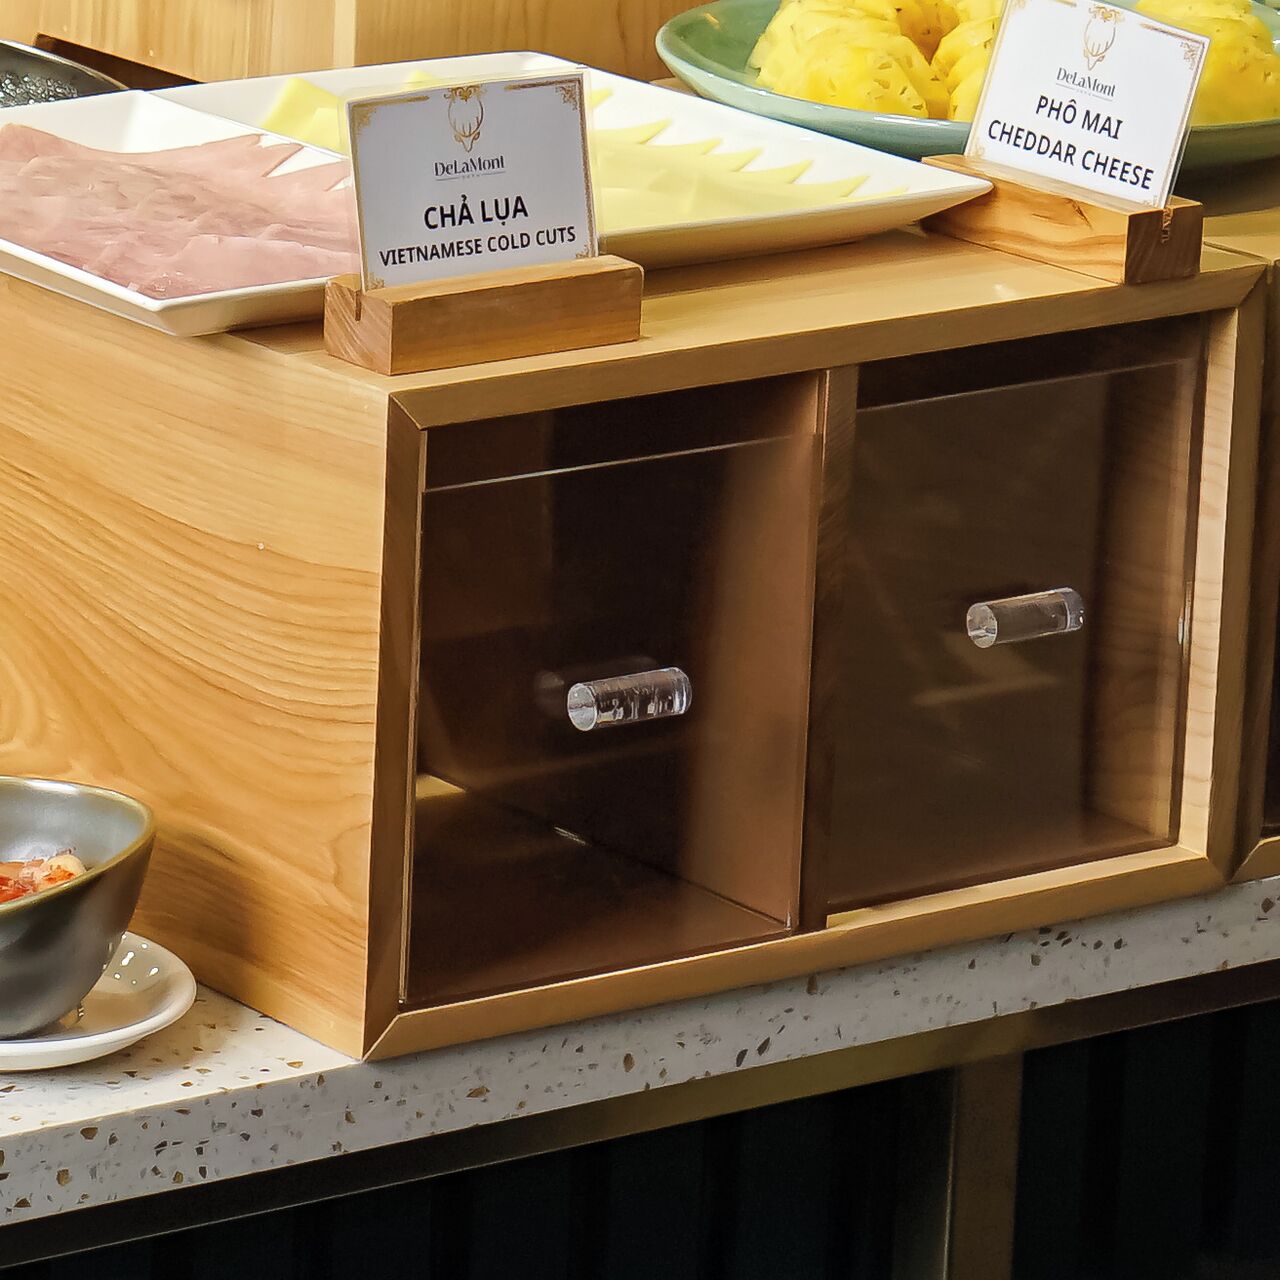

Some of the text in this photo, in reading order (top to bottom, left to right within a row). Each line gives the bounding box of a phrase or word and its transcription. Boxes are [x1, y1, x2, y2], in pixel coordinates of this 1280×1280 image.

[1056, 67, 1116, 97] DeLaMont
[1035, 95, 1123, 140] PHÔ MAI
[434, 156, 505, 176] DeLaMont
[988, 120, 1154, 190] CHEDDAR CHEESE
[424, 194, 529, 230] CHẢ LỤA
[379, 226, 576, 267] VIETNAMESE COLD CUTS
